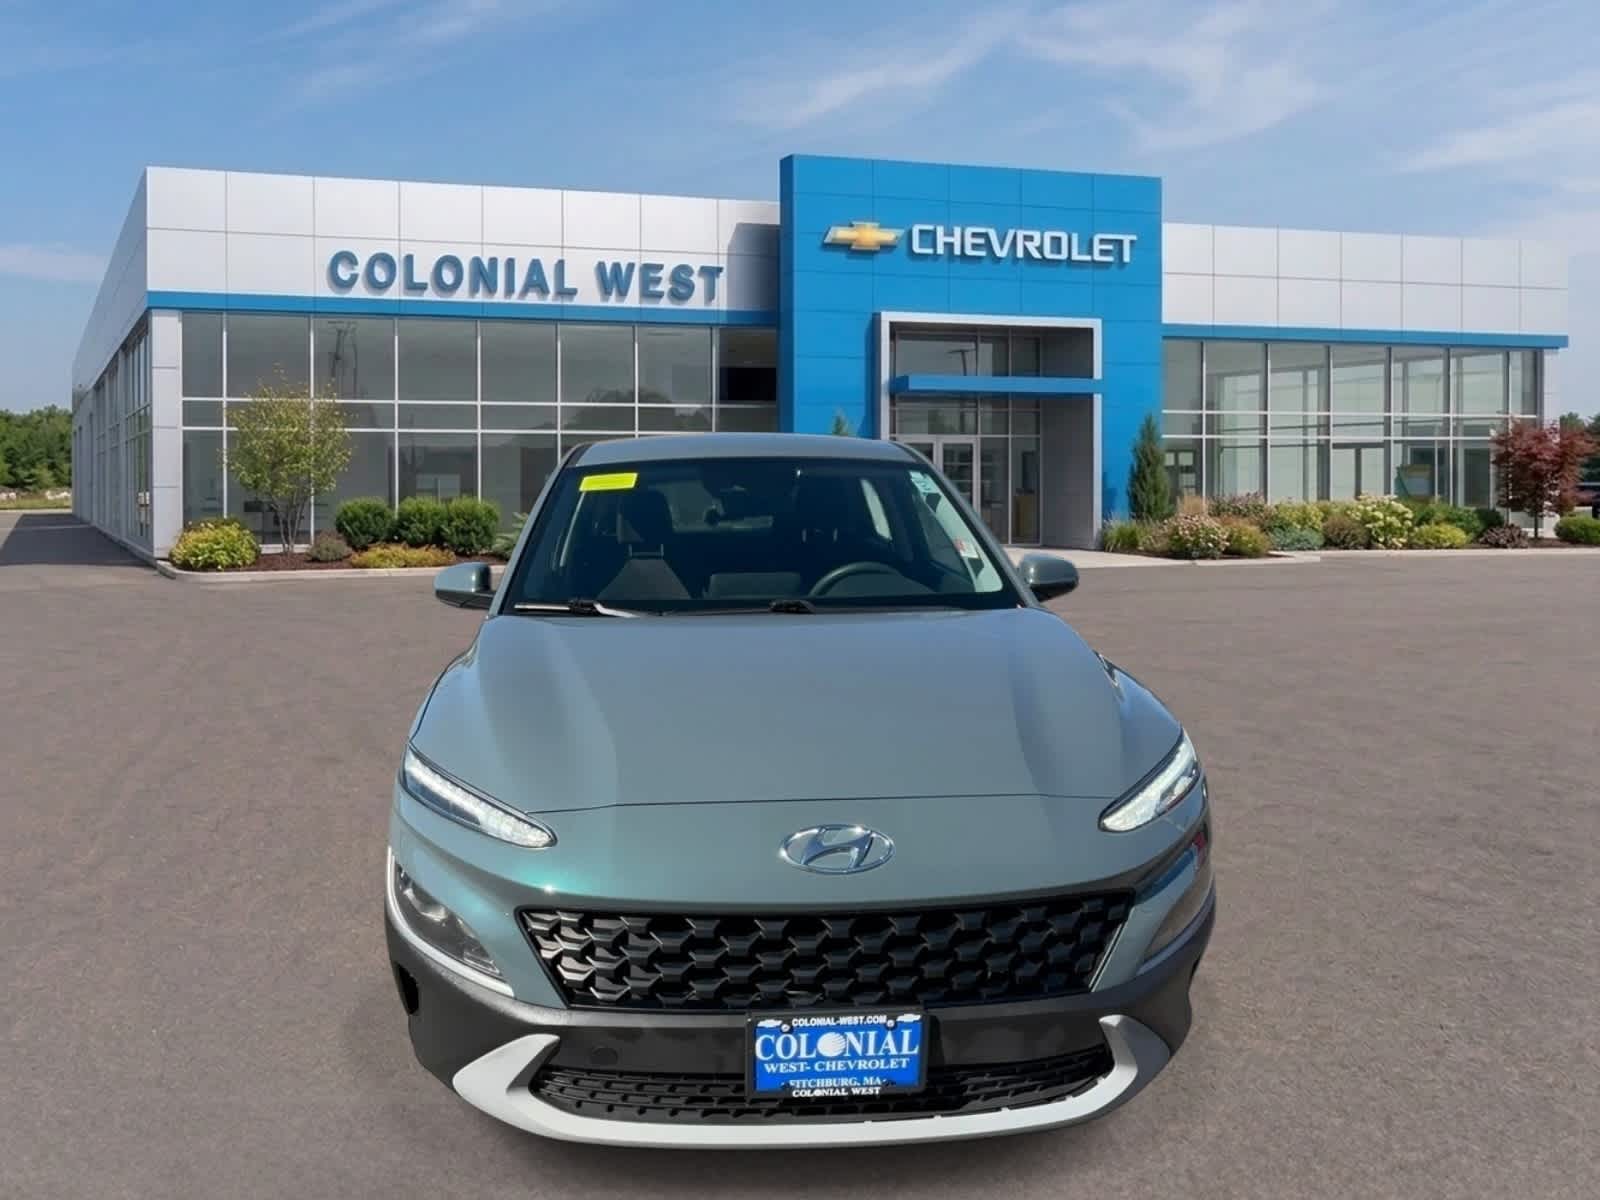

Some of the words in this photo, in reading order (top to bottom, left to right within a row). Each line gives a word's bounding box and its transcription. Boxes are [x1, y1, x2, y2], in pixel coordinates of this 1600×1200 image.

[911, 223, 1137, 263] CHEVROLET
[327, 250, 578, 297] COLONIAL
[595, 260, 723, 304] WEST
[792, 1015, 887, 1027] COLONIAL-WEST.COM
[755, 1029, 919, 1061] COLONIAL
[814, 1058, 909, 1072] CHEVROLET
[792, 1088, 848, 1098] COLONIAL
[851, 1087, 881, 1095] WEST
